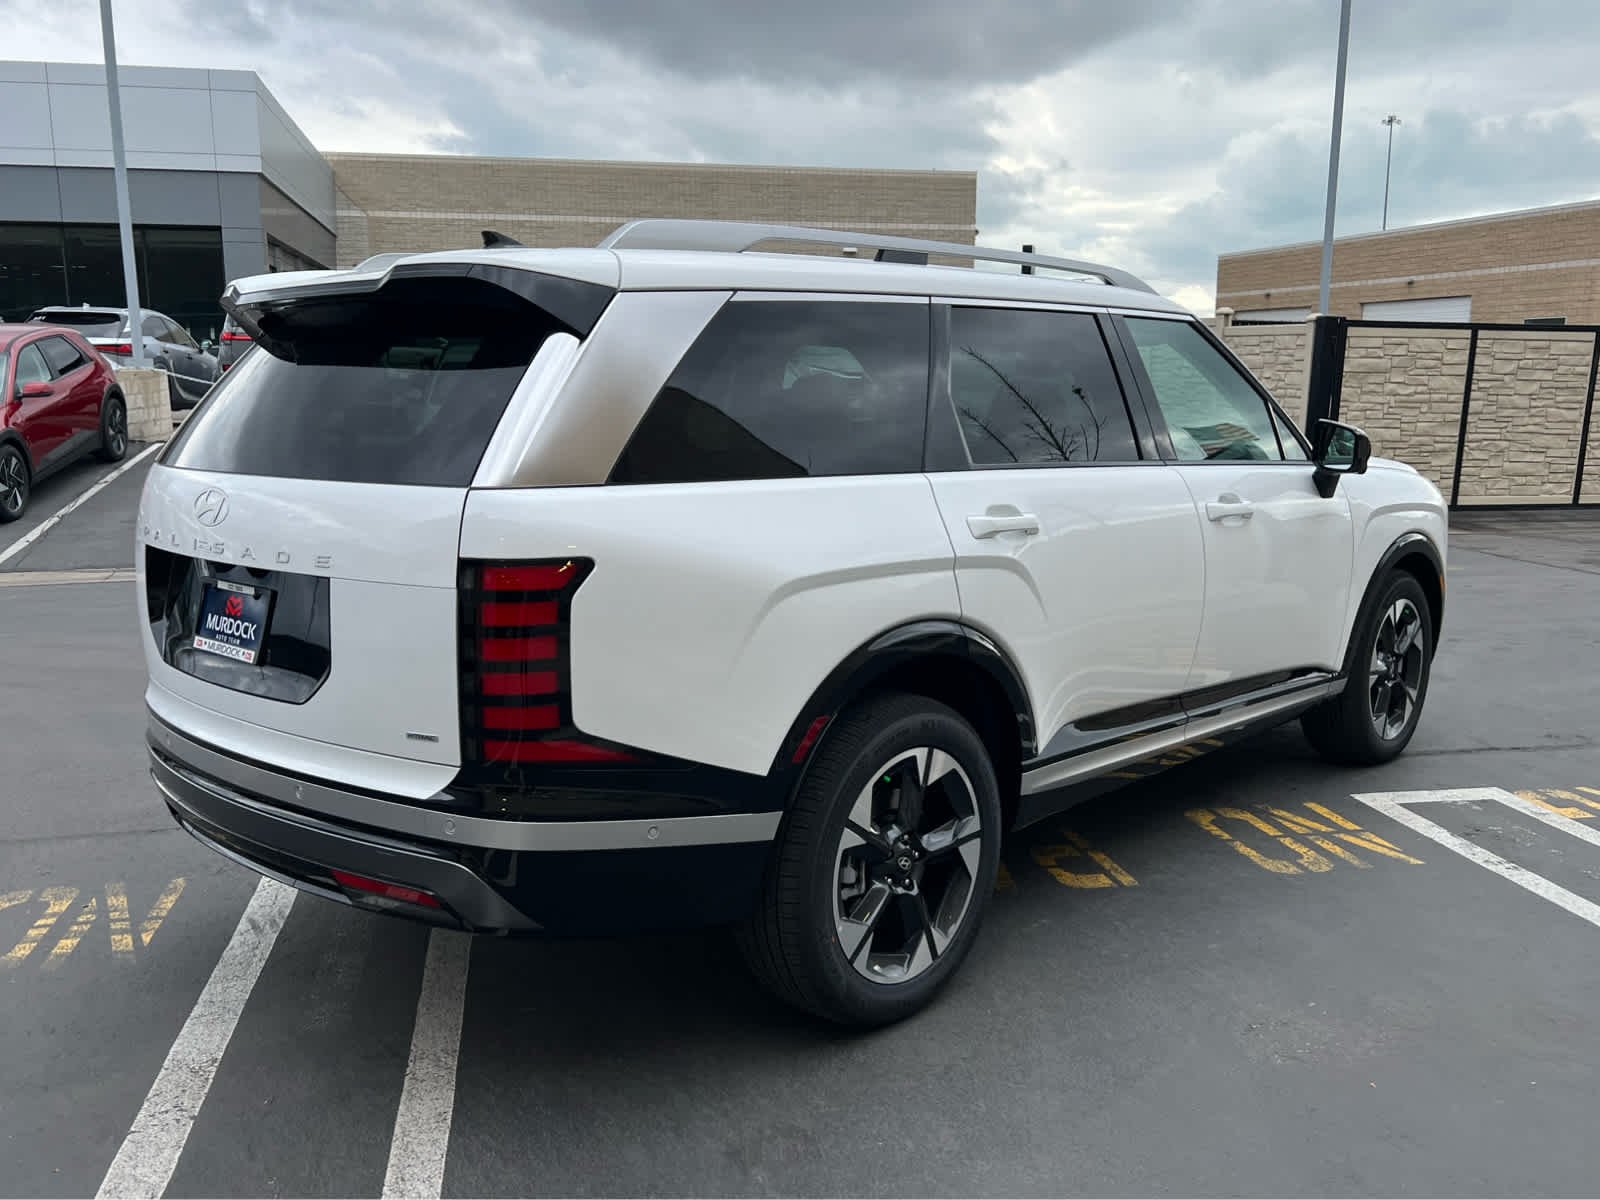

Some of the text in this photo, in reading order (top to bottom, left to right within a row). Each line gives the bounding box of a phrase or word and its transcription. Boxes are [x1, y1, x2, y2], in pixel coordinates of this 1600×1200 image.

[143, 526, 332, 569] PALISADE
[206, 613, 257, 641] MURDOCK
[216, 633, 227, 643] AUTO
[207, 641, 241, 658] MURDOCK
